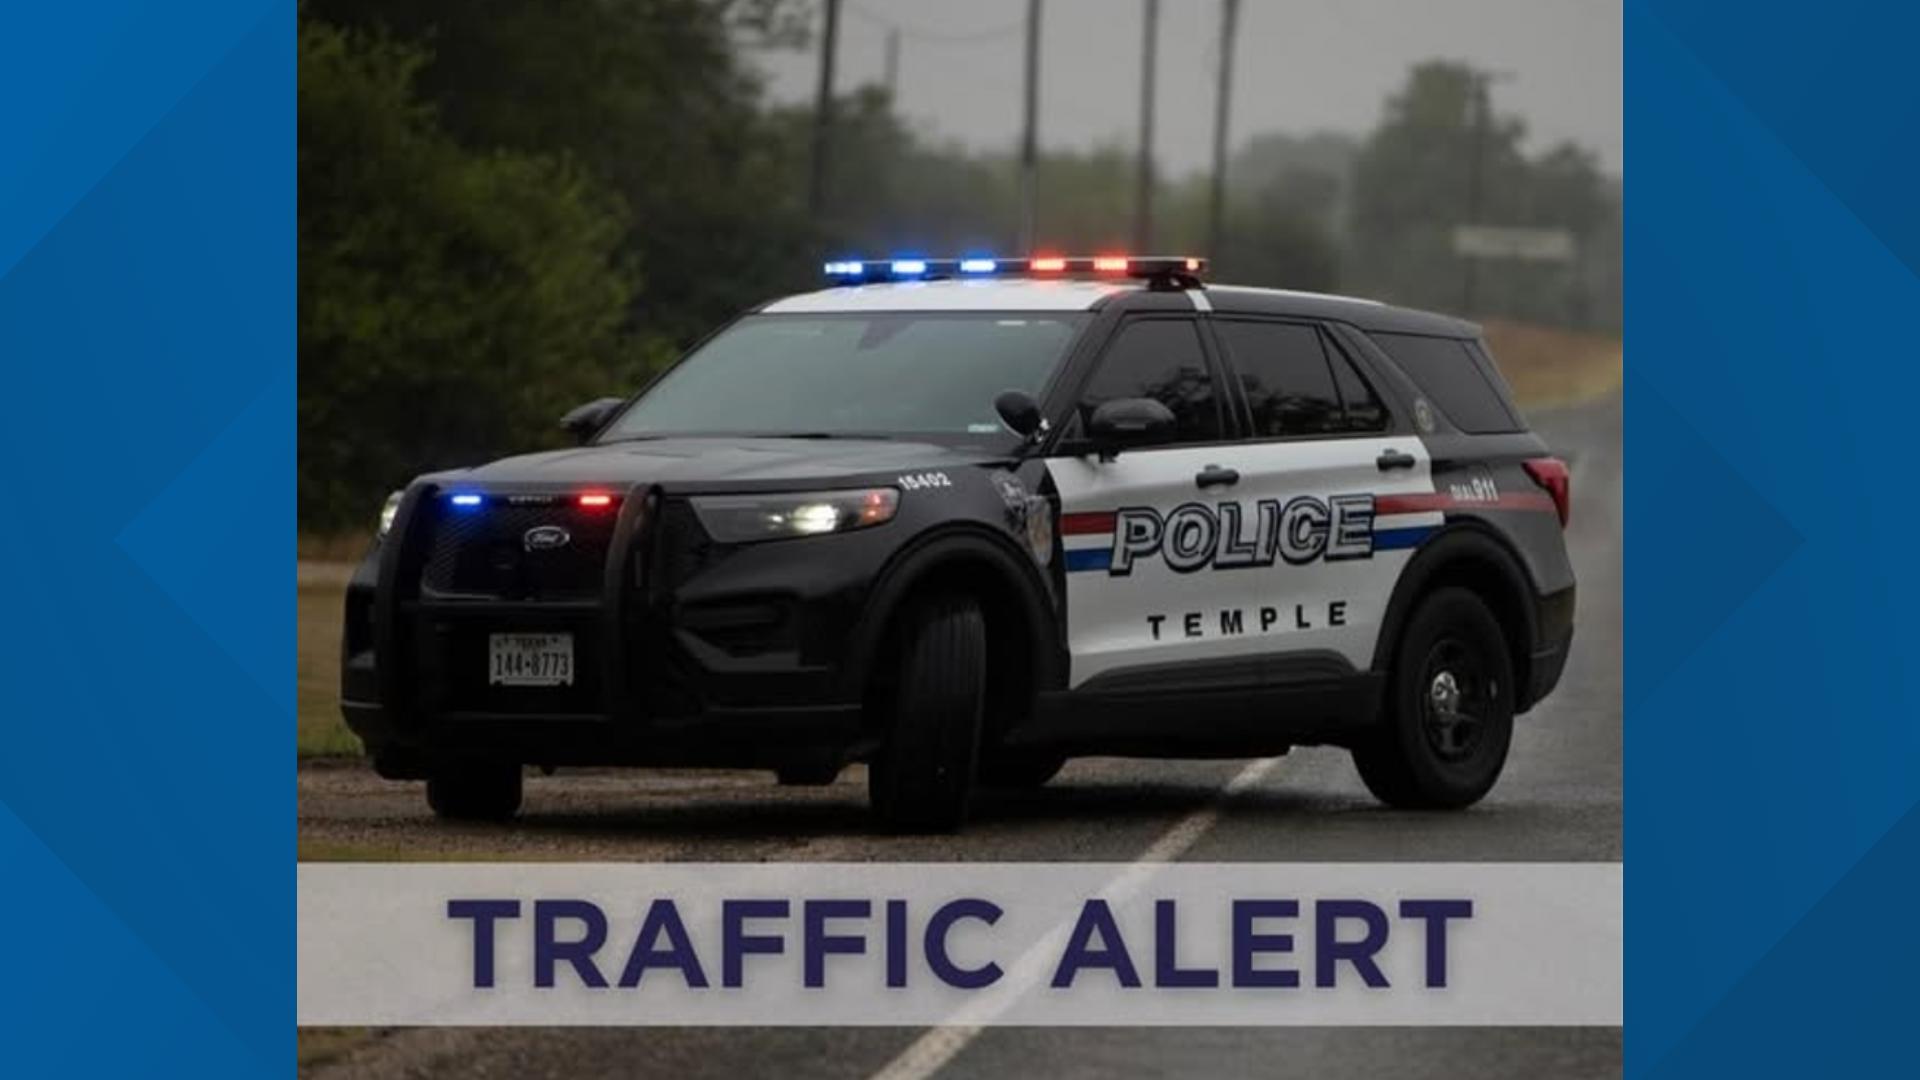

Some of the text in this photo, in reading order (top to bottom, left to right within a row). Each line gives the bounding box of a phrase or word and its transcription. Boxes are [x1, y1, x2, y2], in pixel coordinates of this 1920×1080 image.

[898, 472, 952, 491] 15402
[1472, 477, 1499, 502] 911
[1108, 493, 1376, 576] POLICE
[1148, 602, 1346, 637] TEMPLE
